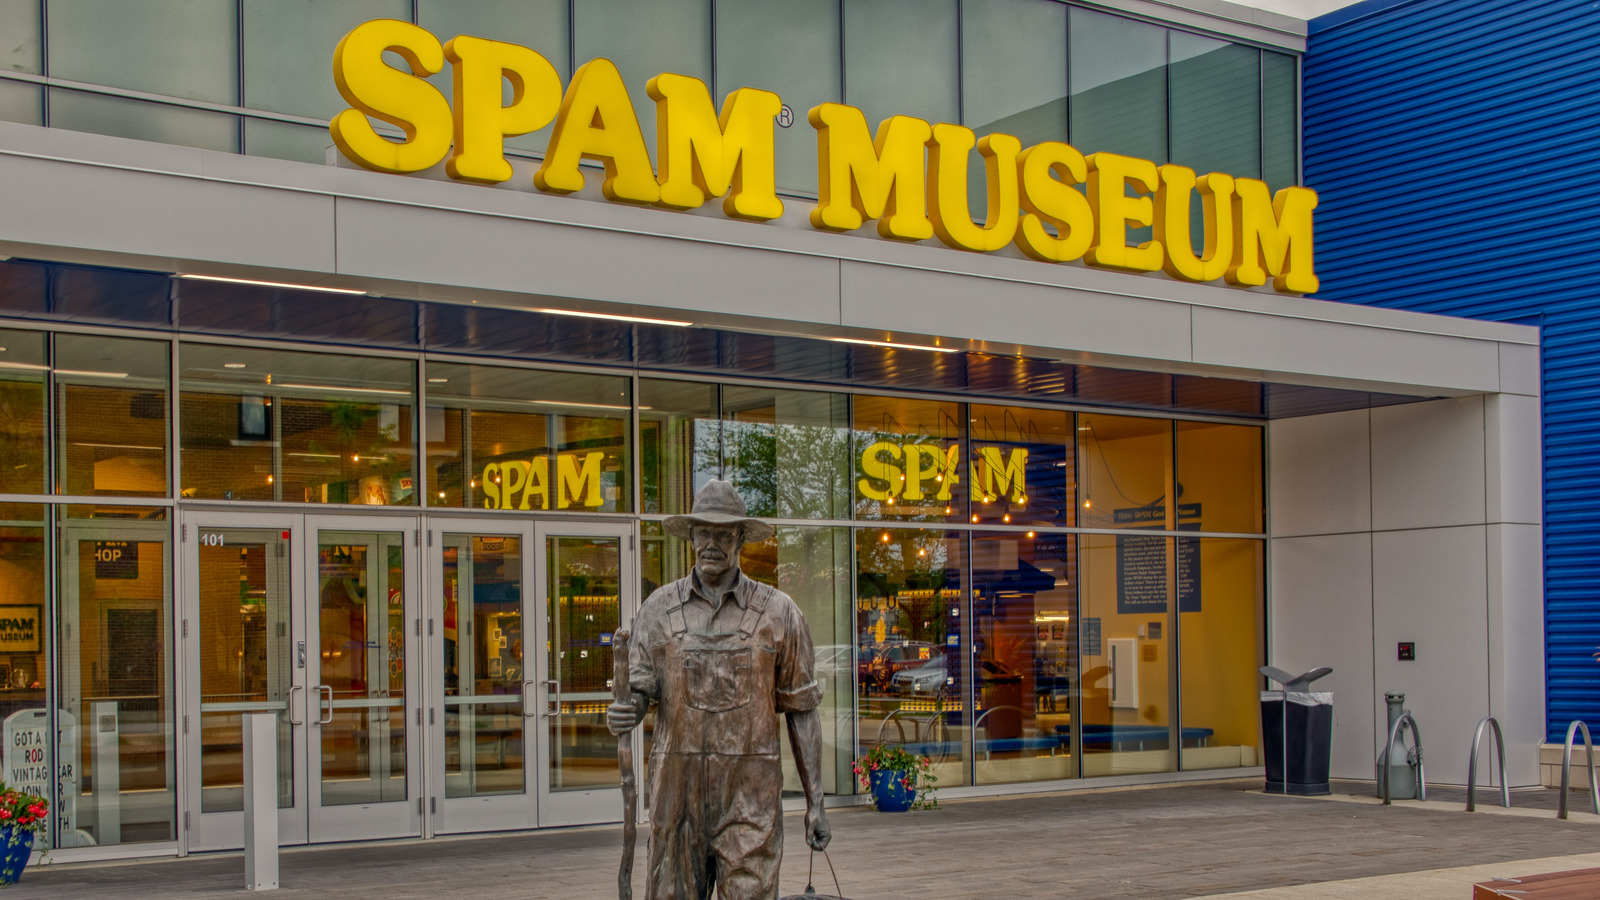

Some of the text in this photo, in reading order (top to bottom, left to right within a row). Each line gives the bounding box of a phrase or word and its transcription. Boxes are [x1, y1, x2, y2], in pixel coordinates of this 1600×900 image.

[330, 18, 784, 221] SPAM
[808, 102, 1320, 294] MUSEUM
[858, 441, 1028, 502] SPAM
[482, 451, 605, 510] SPAM
[1153, 509, 1165, 518] Got
[201, 533, 225, 547] 101
[95, 549, 121, 562] HOP
[0, 618, 34, 631] PAM
[0, 632, 34, 641] USEUM
[15, 732, 33, 746] GOT
[36, 731, 42, 745] A
[25, 748, 44, 764] ROD
[13, 766, 48, 782] VINTAG
